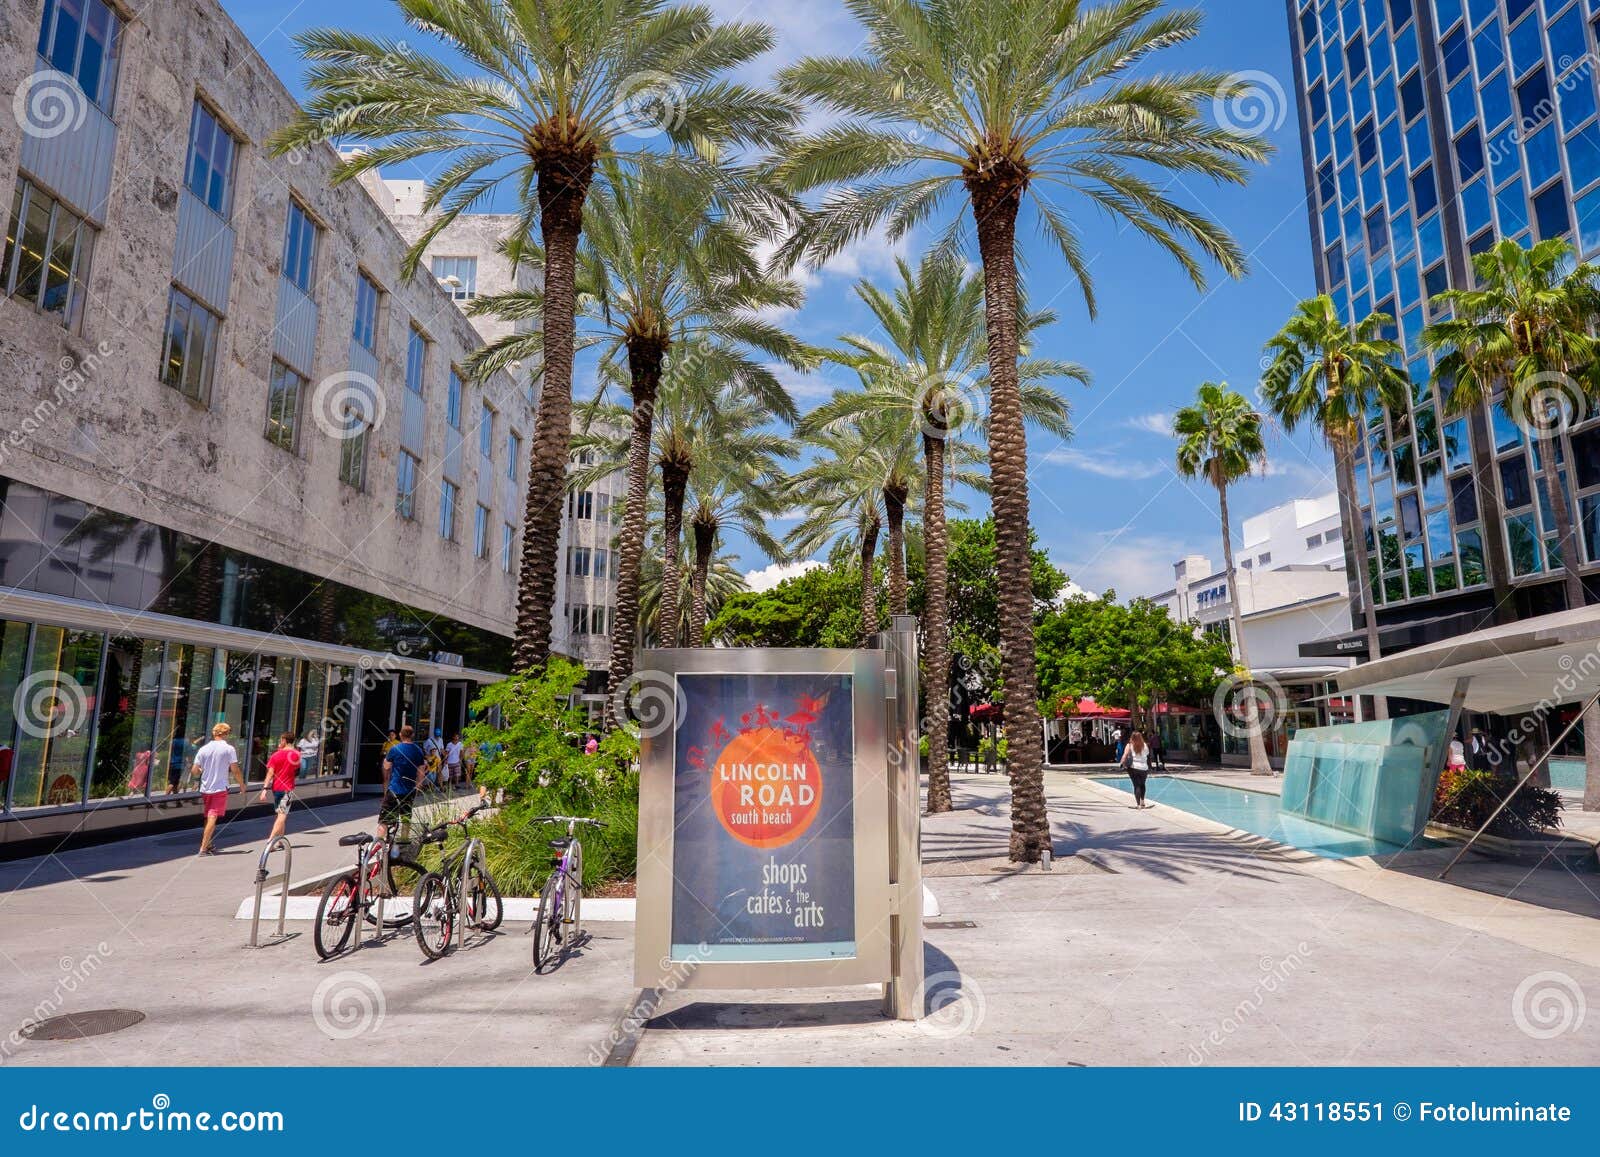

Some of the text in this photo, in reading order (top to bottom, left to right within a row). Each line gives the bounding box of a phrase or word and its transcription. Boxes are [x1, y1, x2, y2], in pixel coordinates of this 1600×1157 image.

[720, 763, 807, 781] LINCOLN
[740, 784, 815, 806] ROAD
[731, 809, 792, 825] south beach
[762, 856, 807, 892] shops
[747, 890, 782, 914] cafés
[796, 889, 810, 903] the
[794, 902, 825, 928] arts
